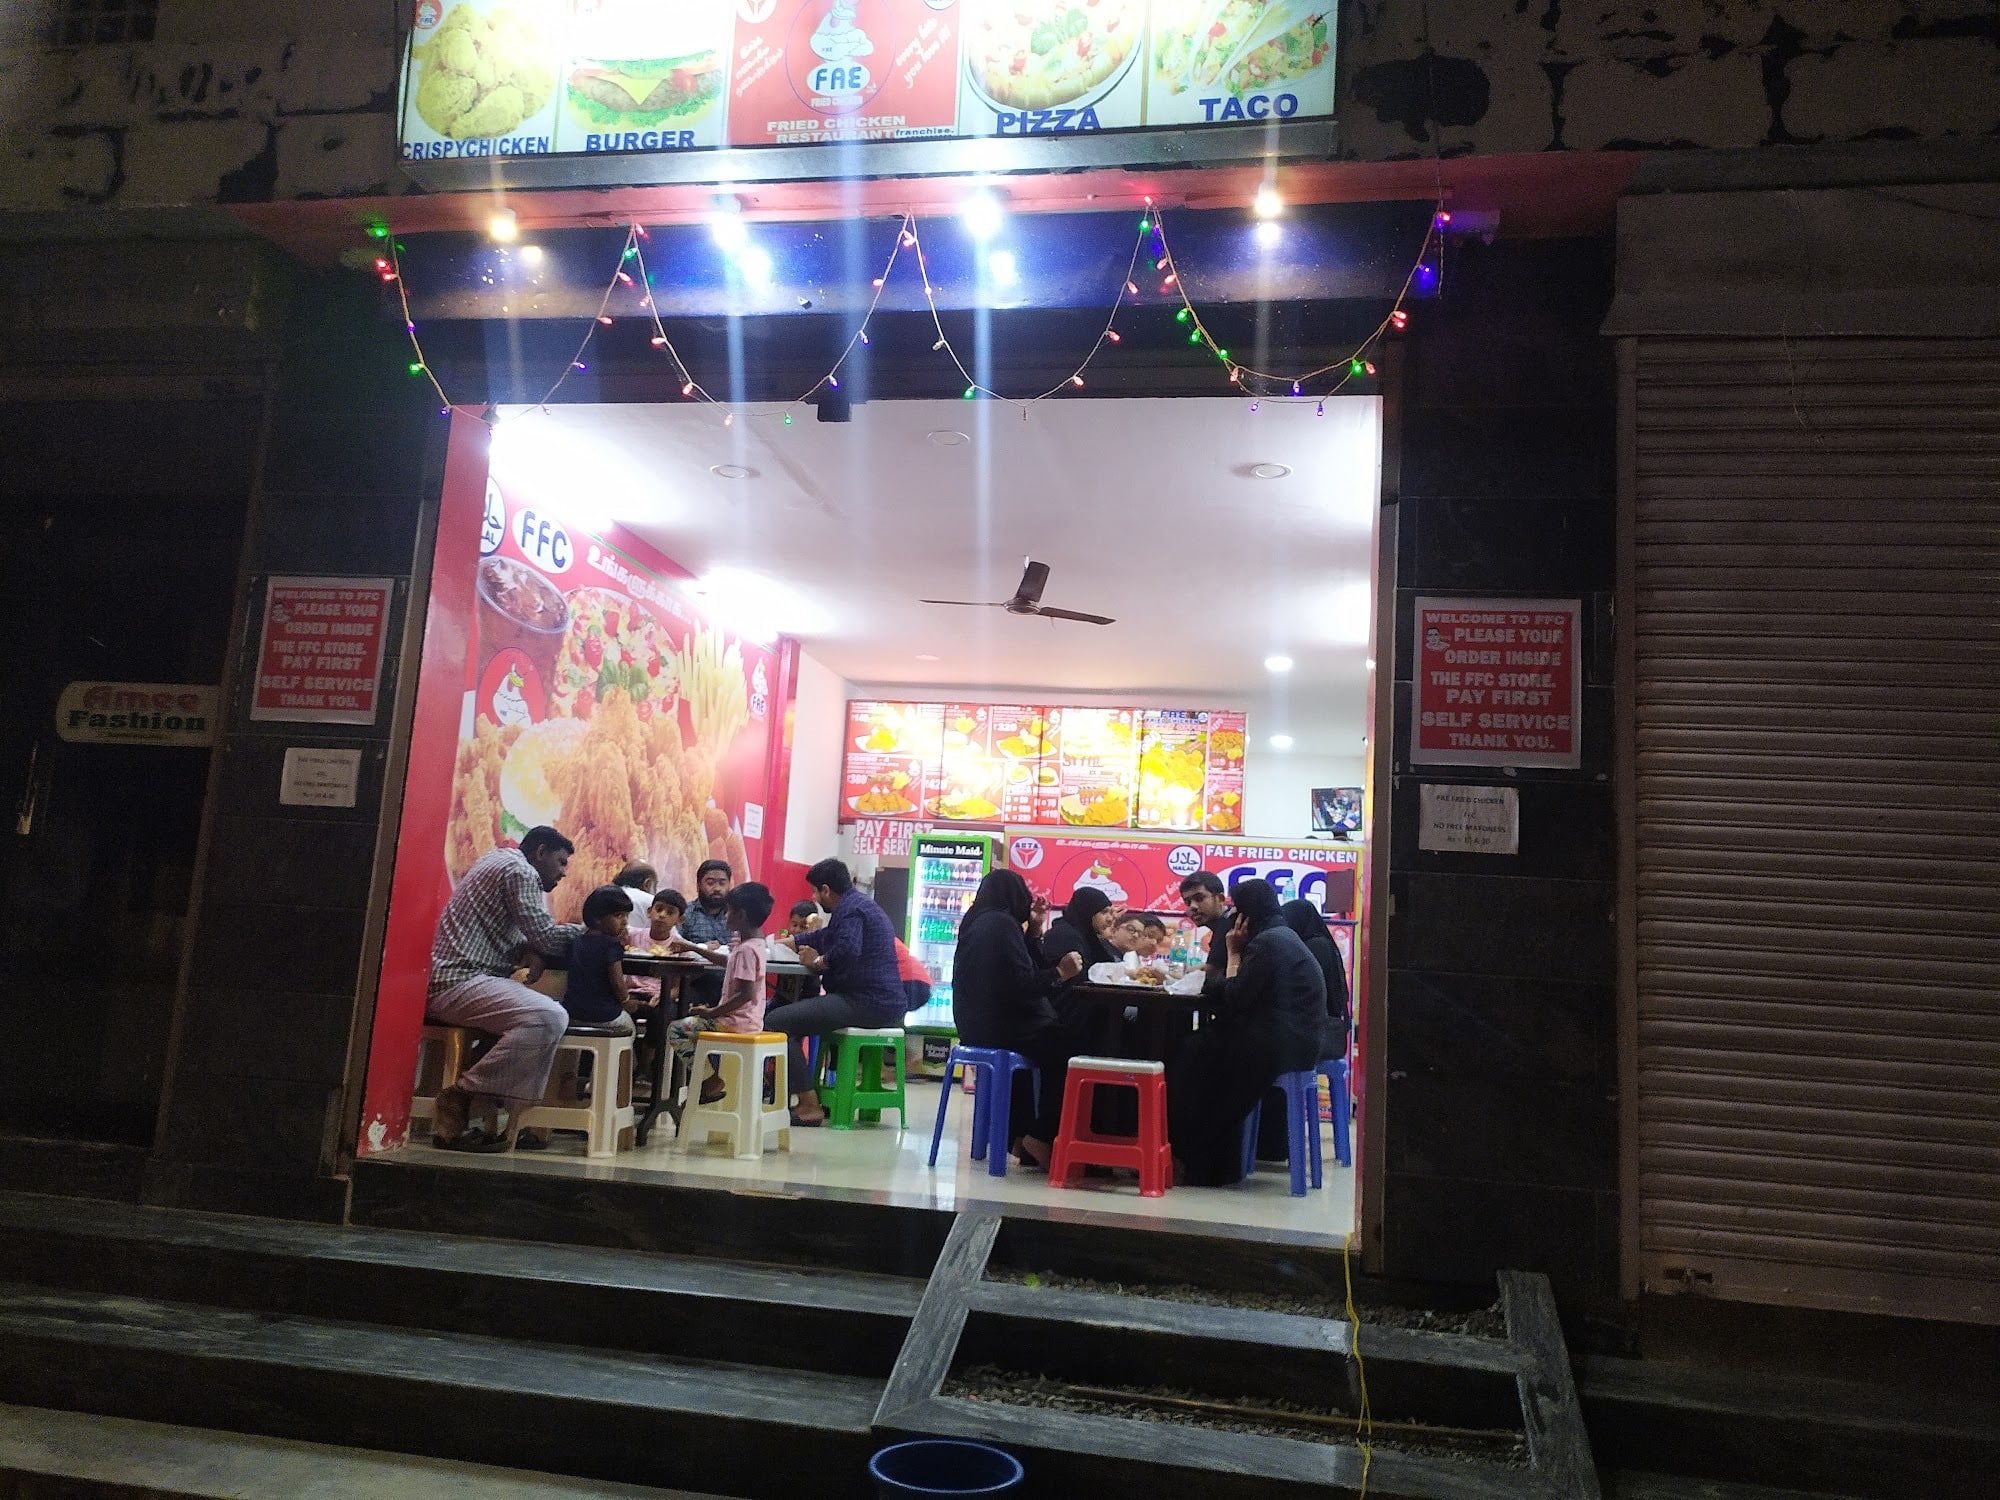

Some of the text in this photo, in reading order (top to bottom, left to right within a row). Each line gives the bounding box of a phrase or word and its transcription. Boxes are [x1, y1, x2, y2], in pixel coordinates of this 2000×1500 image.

[815, 66, 862, 91] FAE
[1199, 93, 1299, 122] TACO
[767, 115, 906, 132] FRIED CHICKEN
[996, 106, 1101, 135] PIZZA
[586, 130, 696, 151] BURGER
[521, 511, 568, 568] FFC
[274, 590, 335, 600] WELCOME
[339, 591, 354, 600] TO
[294, 602, 378, 617] PLEASE YOUR
[1425, 613, 1565, 625] WELCOME TO FFC
[284, 622, 374, 636] ORDER INSIDE
[1454, 628, 1564, 643] PLEASE YOUR
[272, 640, 296, 653] THE
[281, 655, 362, 670] PAY FIRST
[1444, 650, 1562, 666] ORDER INSIDE
[260, 675, 374, 691] SELF SERVICE
[1431, 671, 1556, 688] THE FFC STORE.
[280, 693, 324, 706] THANK
[1446, 689, 1552, 706] PAY FIRST
[67, 710, 206, 731] Fashion
[1160, 710, 1185, 718] FAE
[1421, 712, 1571, 730] SELF SERVICE
[1449, 733, 1555, 748] THANK YOU.
[856, 819, 933, 839] PAY FIRST
[853, 836, 912, 855] SELF SERV
[920, 843, 982, 856] Minute Maid
[1169, 852, 1199, 865] حلال
[1206, 845, 1357, 863] FAE FRIED CHICKEN
